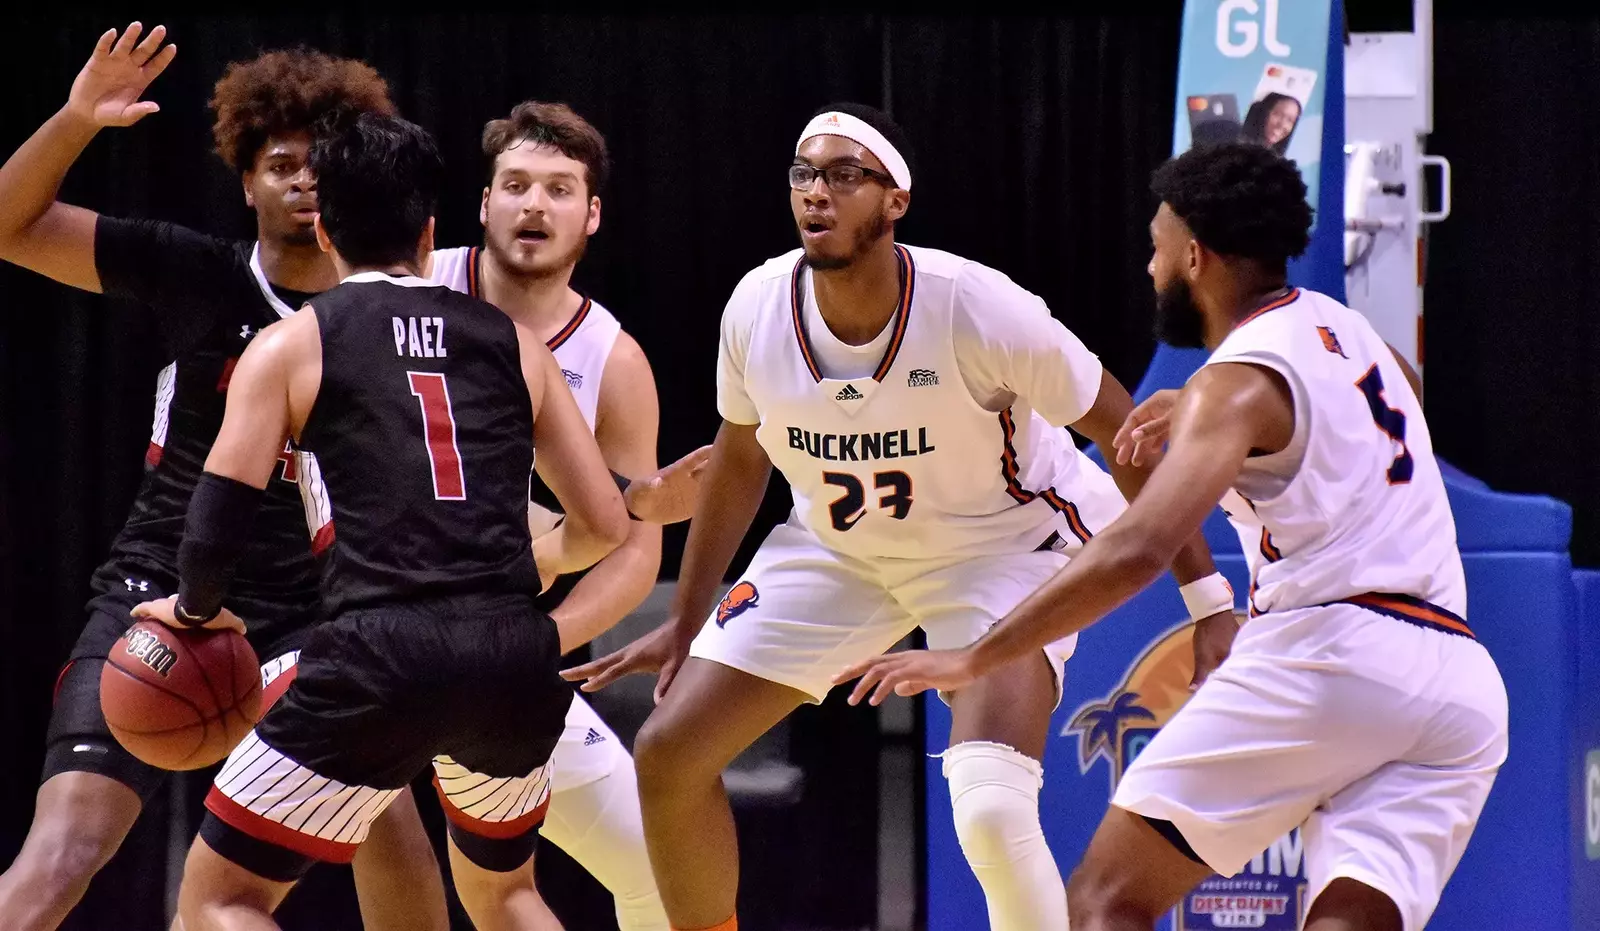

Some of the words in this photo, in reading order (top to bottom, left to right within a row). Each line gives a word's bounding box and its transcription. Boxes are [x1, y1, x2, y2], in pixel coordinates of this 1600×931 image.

[392, 316, 447, 358] PAEZ
[835, 392, 864, 401] adidas
[406, 370, 467, 500] 1
[1353, 361, 1414, 486] 5
[786, 426, 936, 461] BUCKNELL
[822, 470, 915, 532] 23
[1193, 896, 1287, 913] DISCOUNT
[1219, 914, 1258, 924] TIRE
